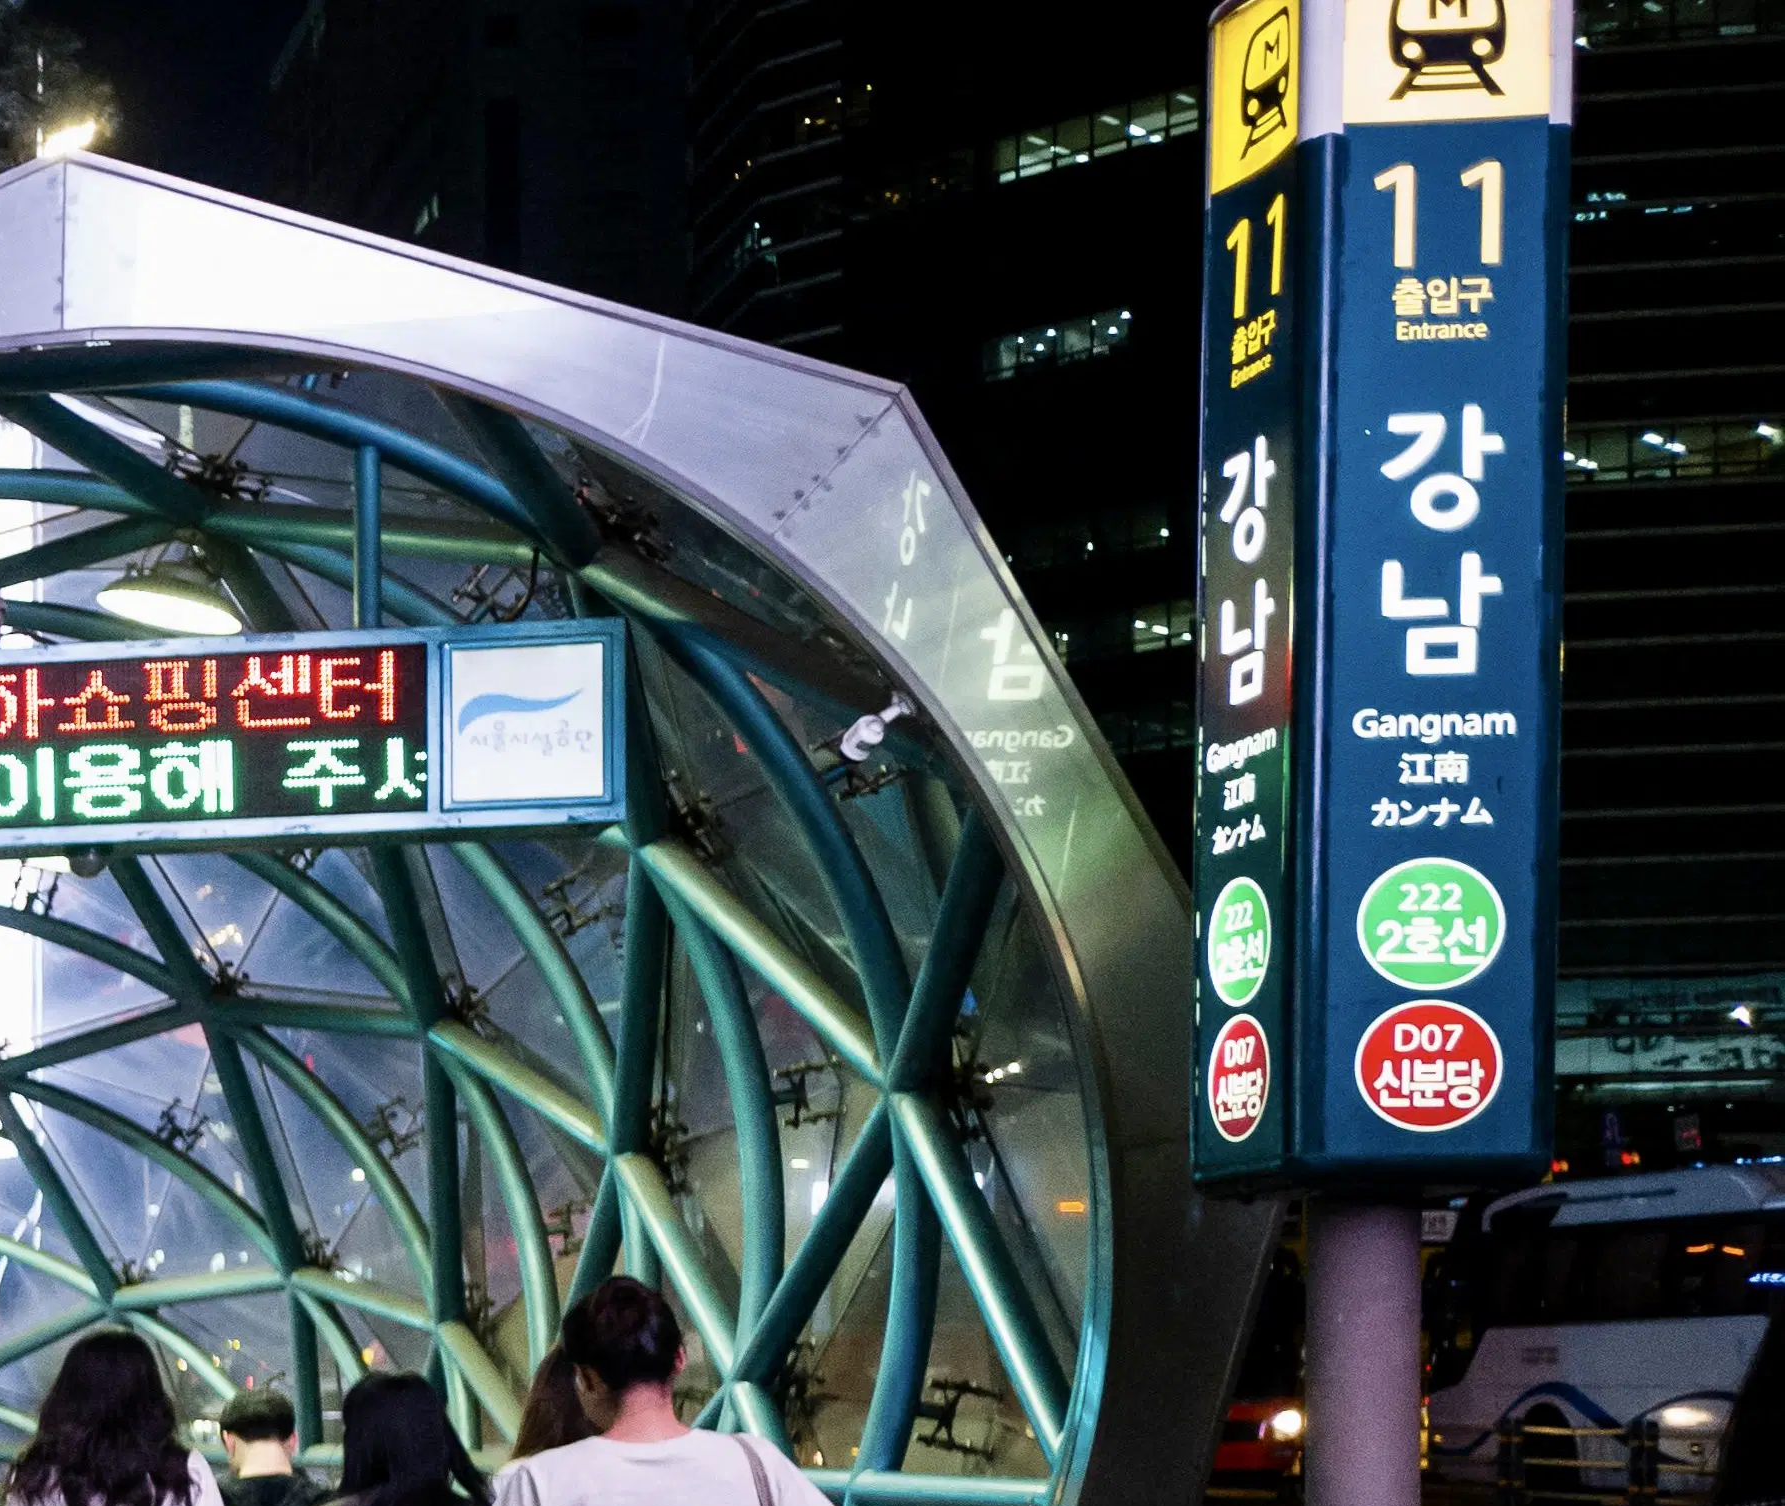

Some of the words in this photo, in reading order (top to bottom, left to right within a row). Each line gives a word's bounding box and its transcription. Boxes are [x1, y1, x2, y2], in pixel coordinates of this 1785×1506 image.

[1373, 160, 1504, 269] 11
[1226, 193, 1285, 319] 11
[1392, 275, 1495, 317] 출입구
[1231, 309, 1276, 365] 출입구
[1395, 320, 1489, 342] Entrance
[1380, 402, 1505, 677] 강남
[1220, 434, 1276, 707] 강남
[469, 718, 594, 757] 서울시설공단
[1352, 707, 1518, 744] Gangnam
[1206, 727, 1277, 773] Gangnam
[1398, 750, 1470, 785] 江南
[1371, 796, 1494, 828] カンナム
[1211, 813, 1267, 856] カンナム
[1224, 899, 1255, 932] 222
[1398, 882, 1464, 913] 222
[1216, 928, 1266, 986] 2호선
[1375, 915, 1488, 965] 2호선
[1224, 1035, 1256, 1069] D07
[1393, 1022, 1465, 1053] D07
[1215, 1066, 1265, 1122] 신분당
[1372, 1058, 1486, 1109] 신분당
